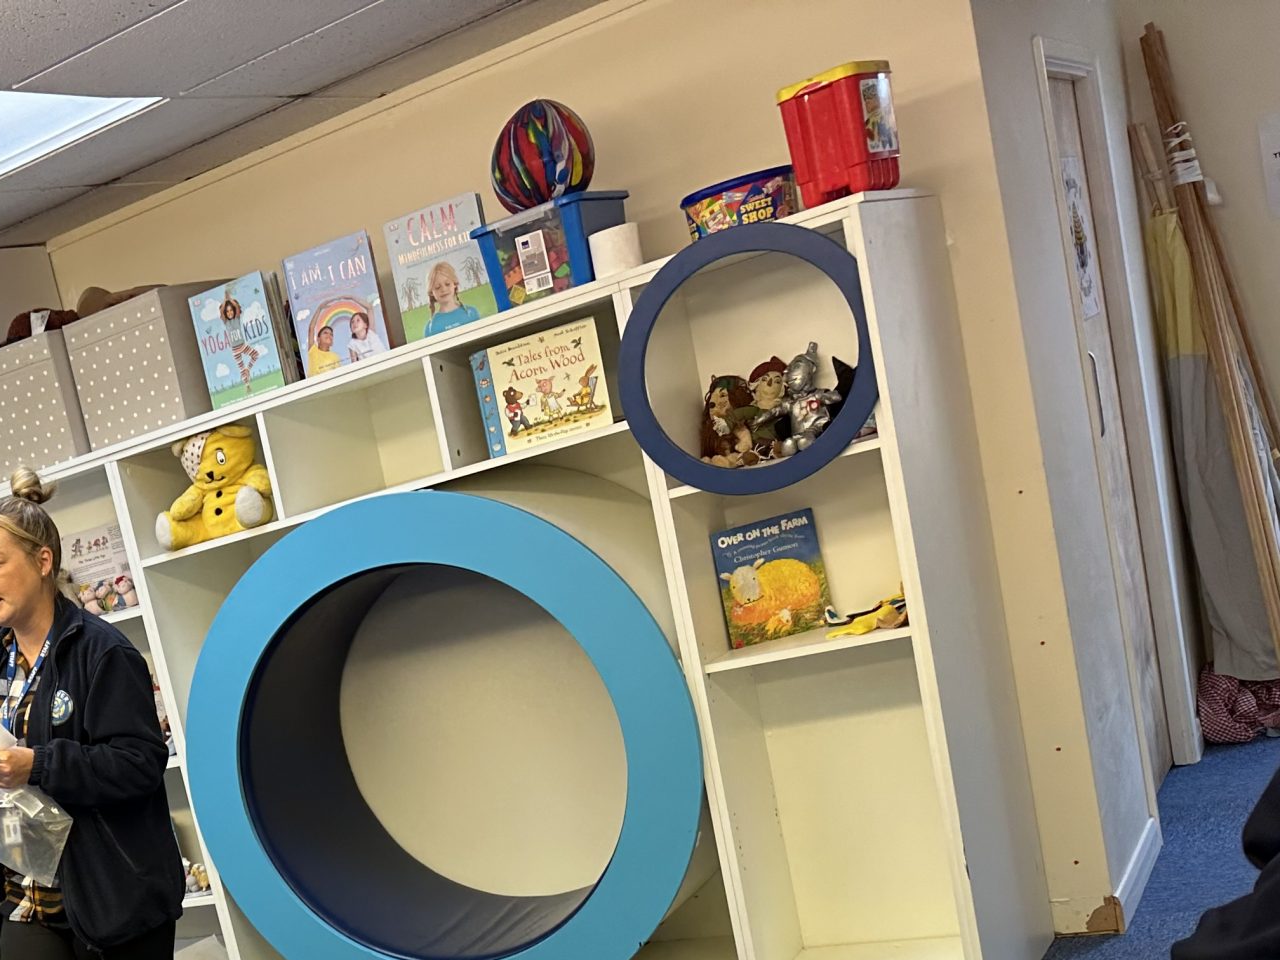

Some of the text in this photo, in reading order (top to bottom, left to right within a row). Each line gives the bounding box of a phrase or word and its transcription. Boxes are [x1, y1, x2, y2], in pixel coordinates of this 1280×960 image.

[740, 197, 772, 214] SWEET
[741, 207, 774, 225] SHOP
[407, 203, 457, 246] CALM
[398, 242, 445, 265] MINDFULNESS
[444, 237, 457, 250] FOR
[339, 255, 367, 280] CAN
[201, 330, 232, 357] YOGA
[242, 315, 269, 342] KIDS
[509, 347, 585, 383] Acorn Wood
[516, 343, 570, 367] Tales from
[717, 533, 744, 549] OVER
[745, 528, 760, 541] ON
[761, 525, 780, 538] THE
[780, 516, 808, 531] FARM
[734, 549, 771, 564] Christopher
